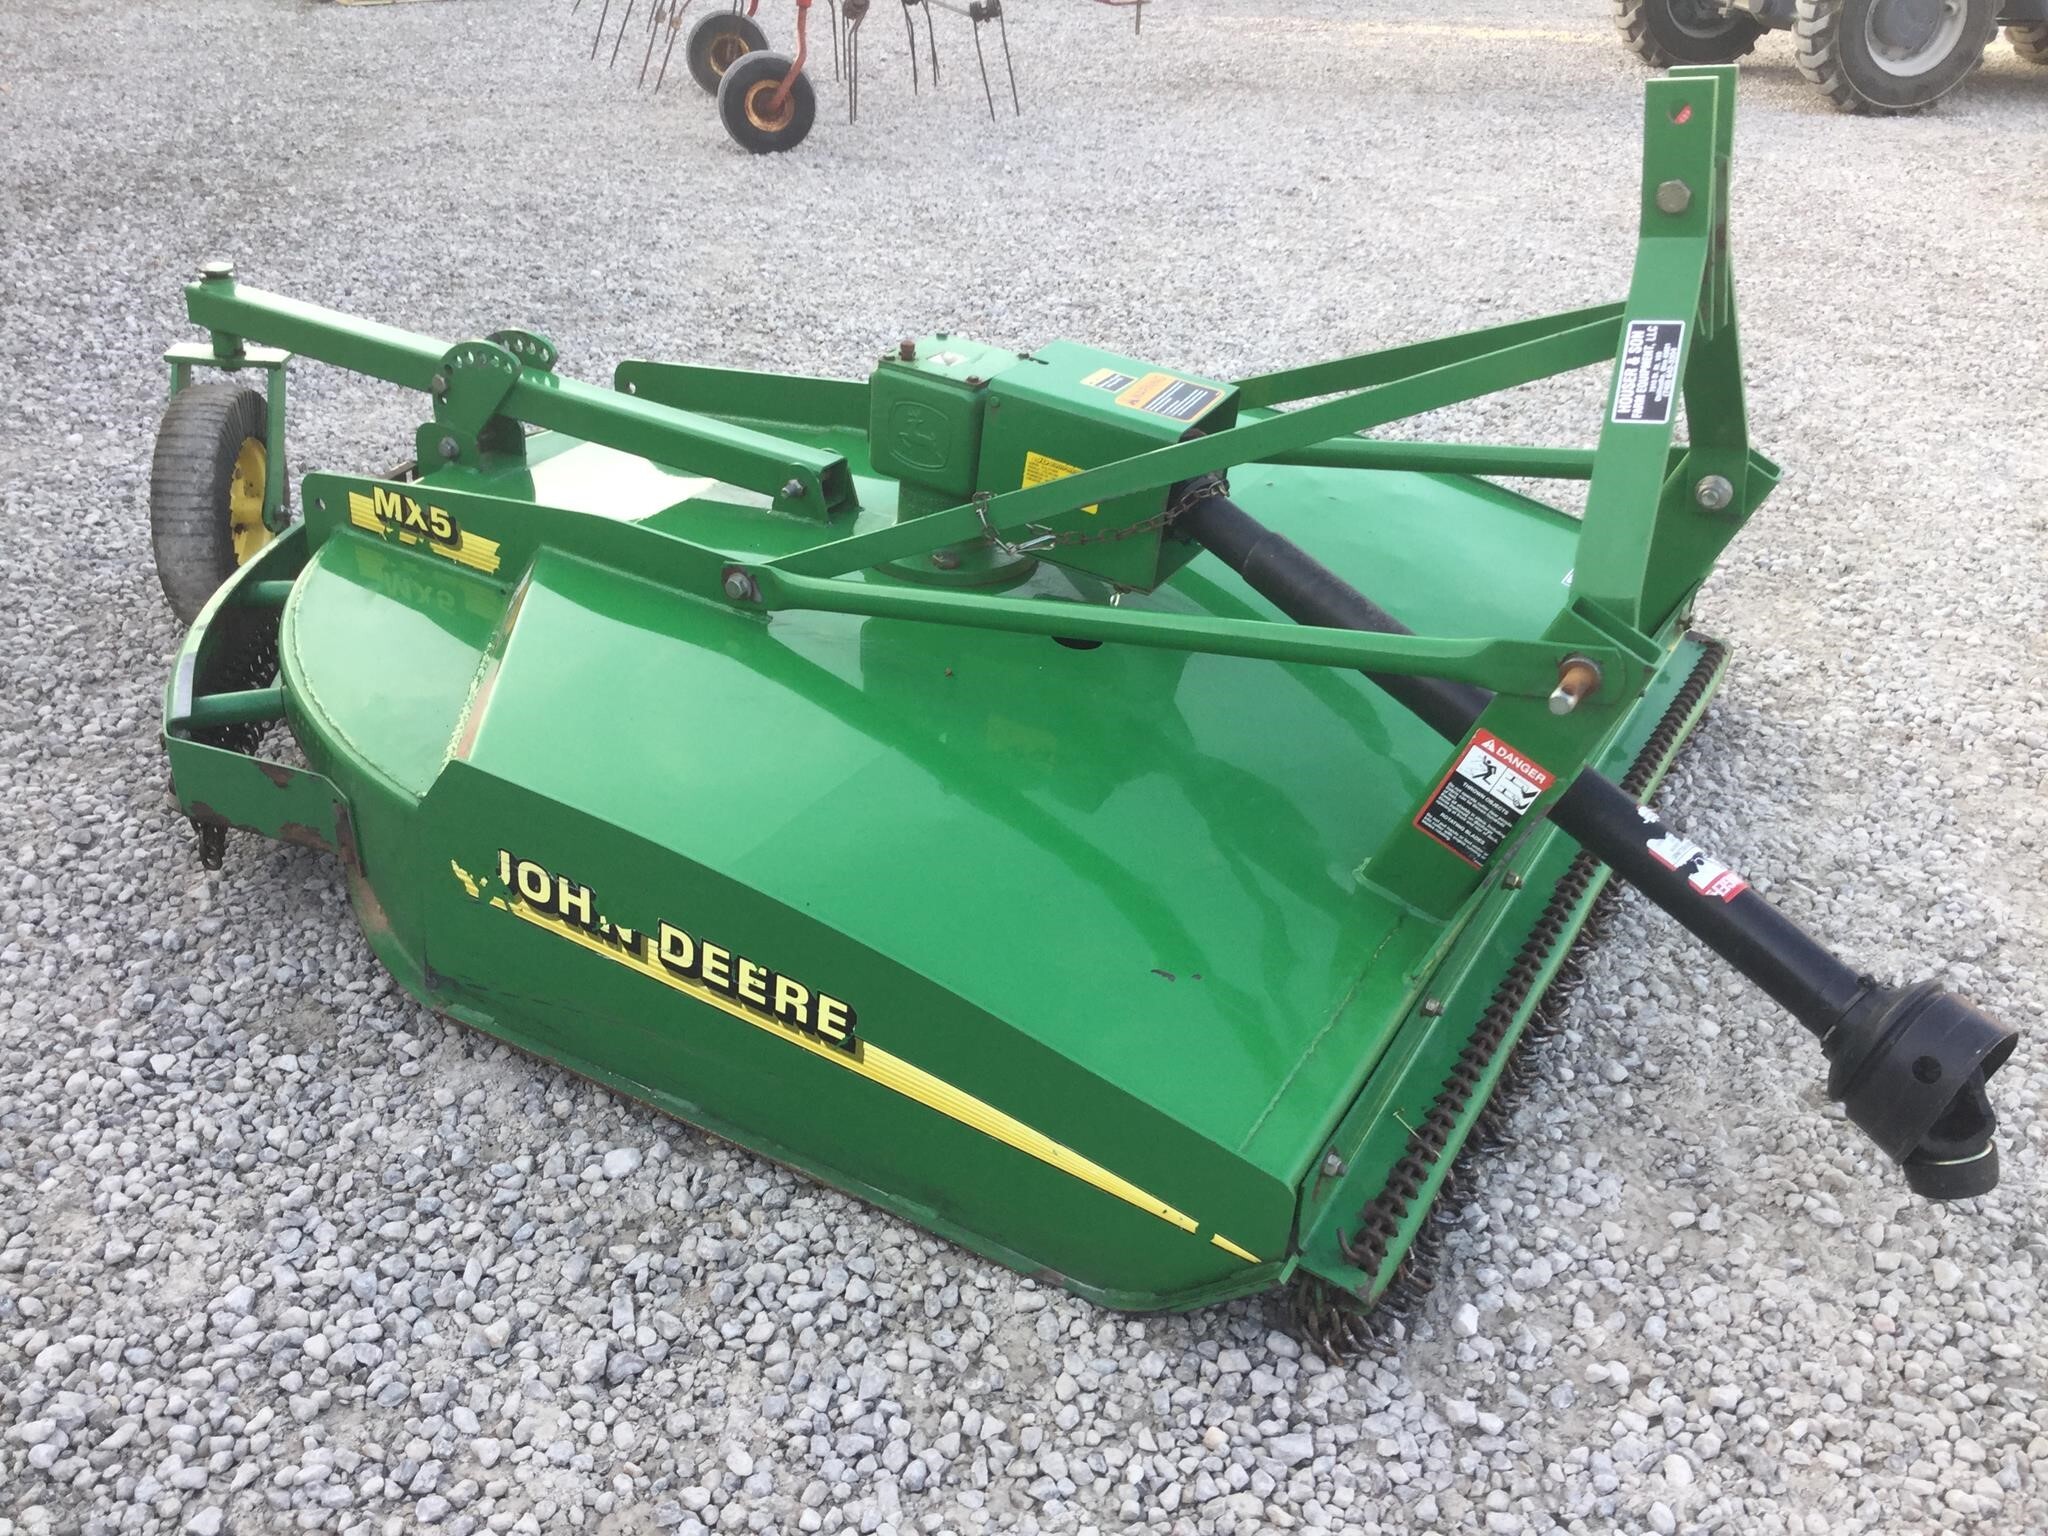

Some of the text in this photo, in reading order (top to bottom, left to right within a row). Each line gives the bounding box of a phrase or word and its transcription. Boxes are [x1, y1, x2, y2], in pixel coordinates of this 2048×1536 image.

[1617, 330, 1645, 412] HOUSER & SON
[1631, 394, 1645, 418] FARM
[1644, 325, 1658, 341] LLC
[373, 486, 453, 539] MX5
[1495, 746, 1547, 784] DANGER
[659, 919, 856, 1046] DEERE
